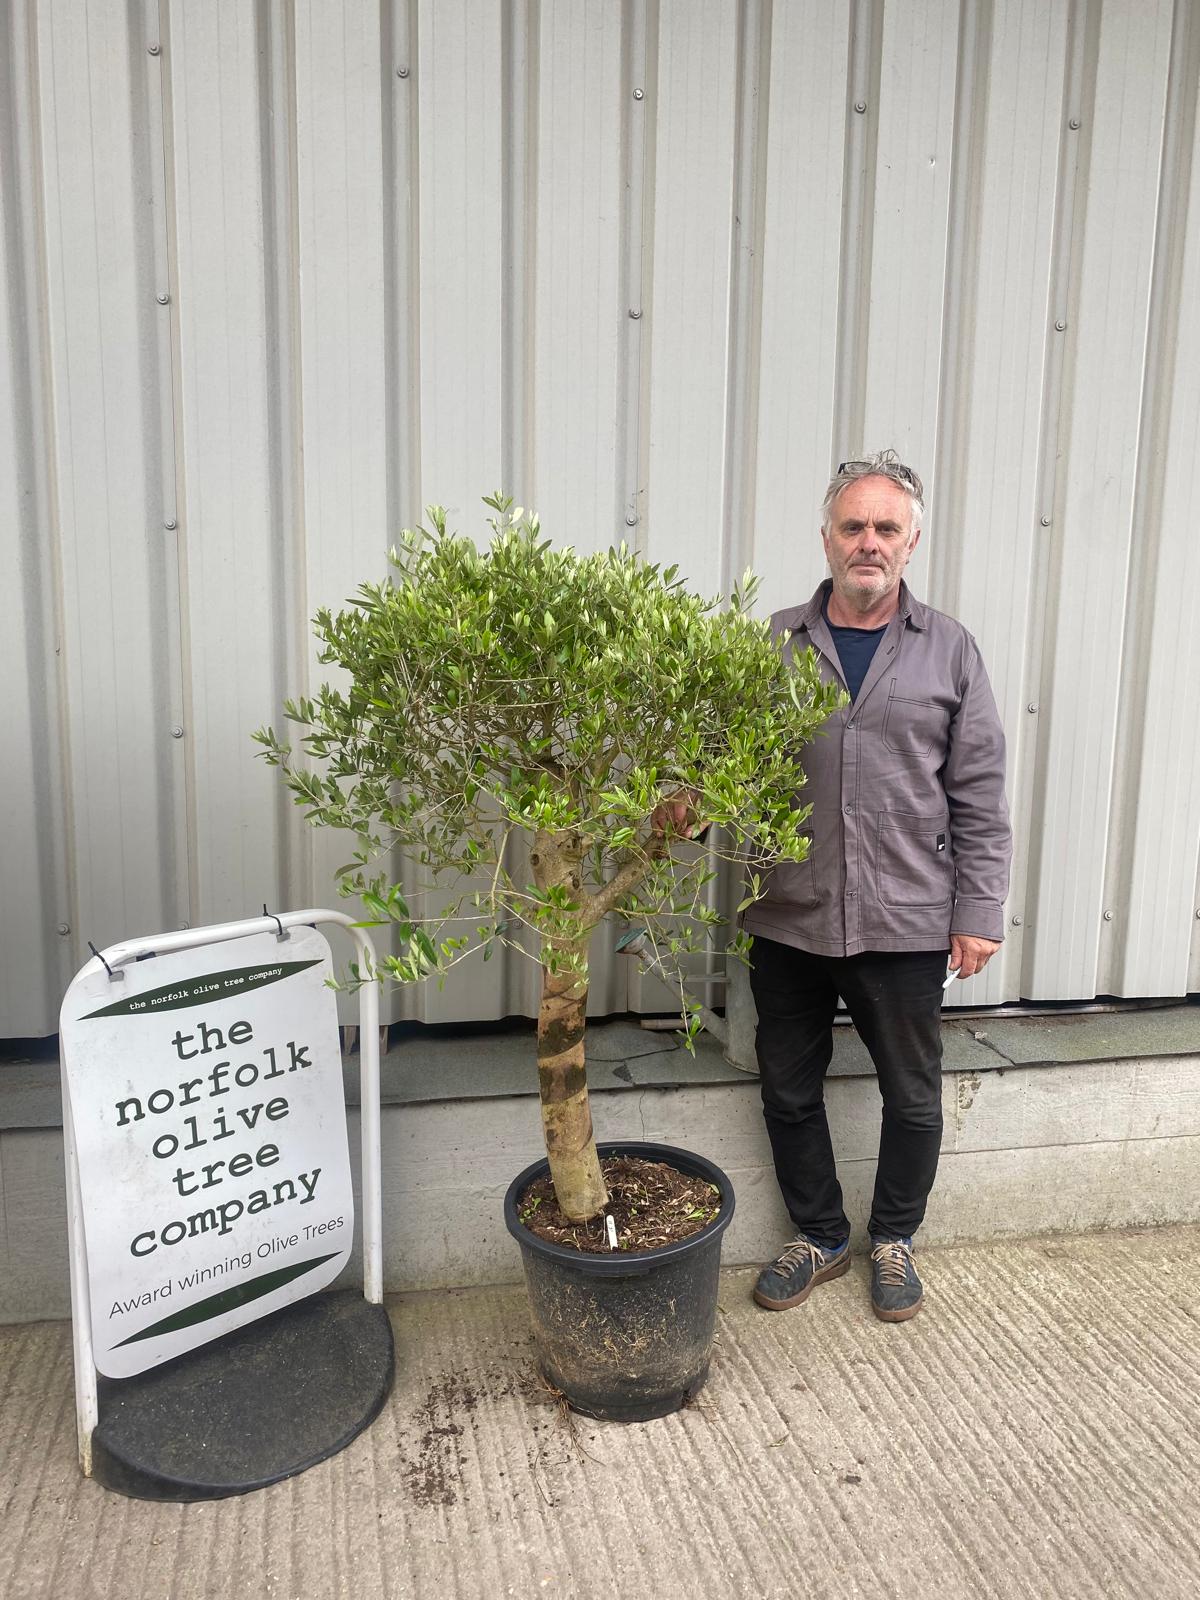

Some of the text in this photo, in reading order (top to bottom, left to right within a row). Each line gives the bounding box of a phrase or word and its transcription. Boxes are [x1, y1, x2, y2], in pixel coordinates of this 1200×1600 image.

[129, 967, 283, 1010] the norfolk olive tree company
[172, 1020, 254, 1060] the
[115, 1041, 313, 1127] norfolk
[152, 1097, 290, 1159] olive
[172, 1143, 280, 1197] tree
[130, 1168, 322, 1257] company
[109, 1215, 344, 1319] Award winning Olive Trees
